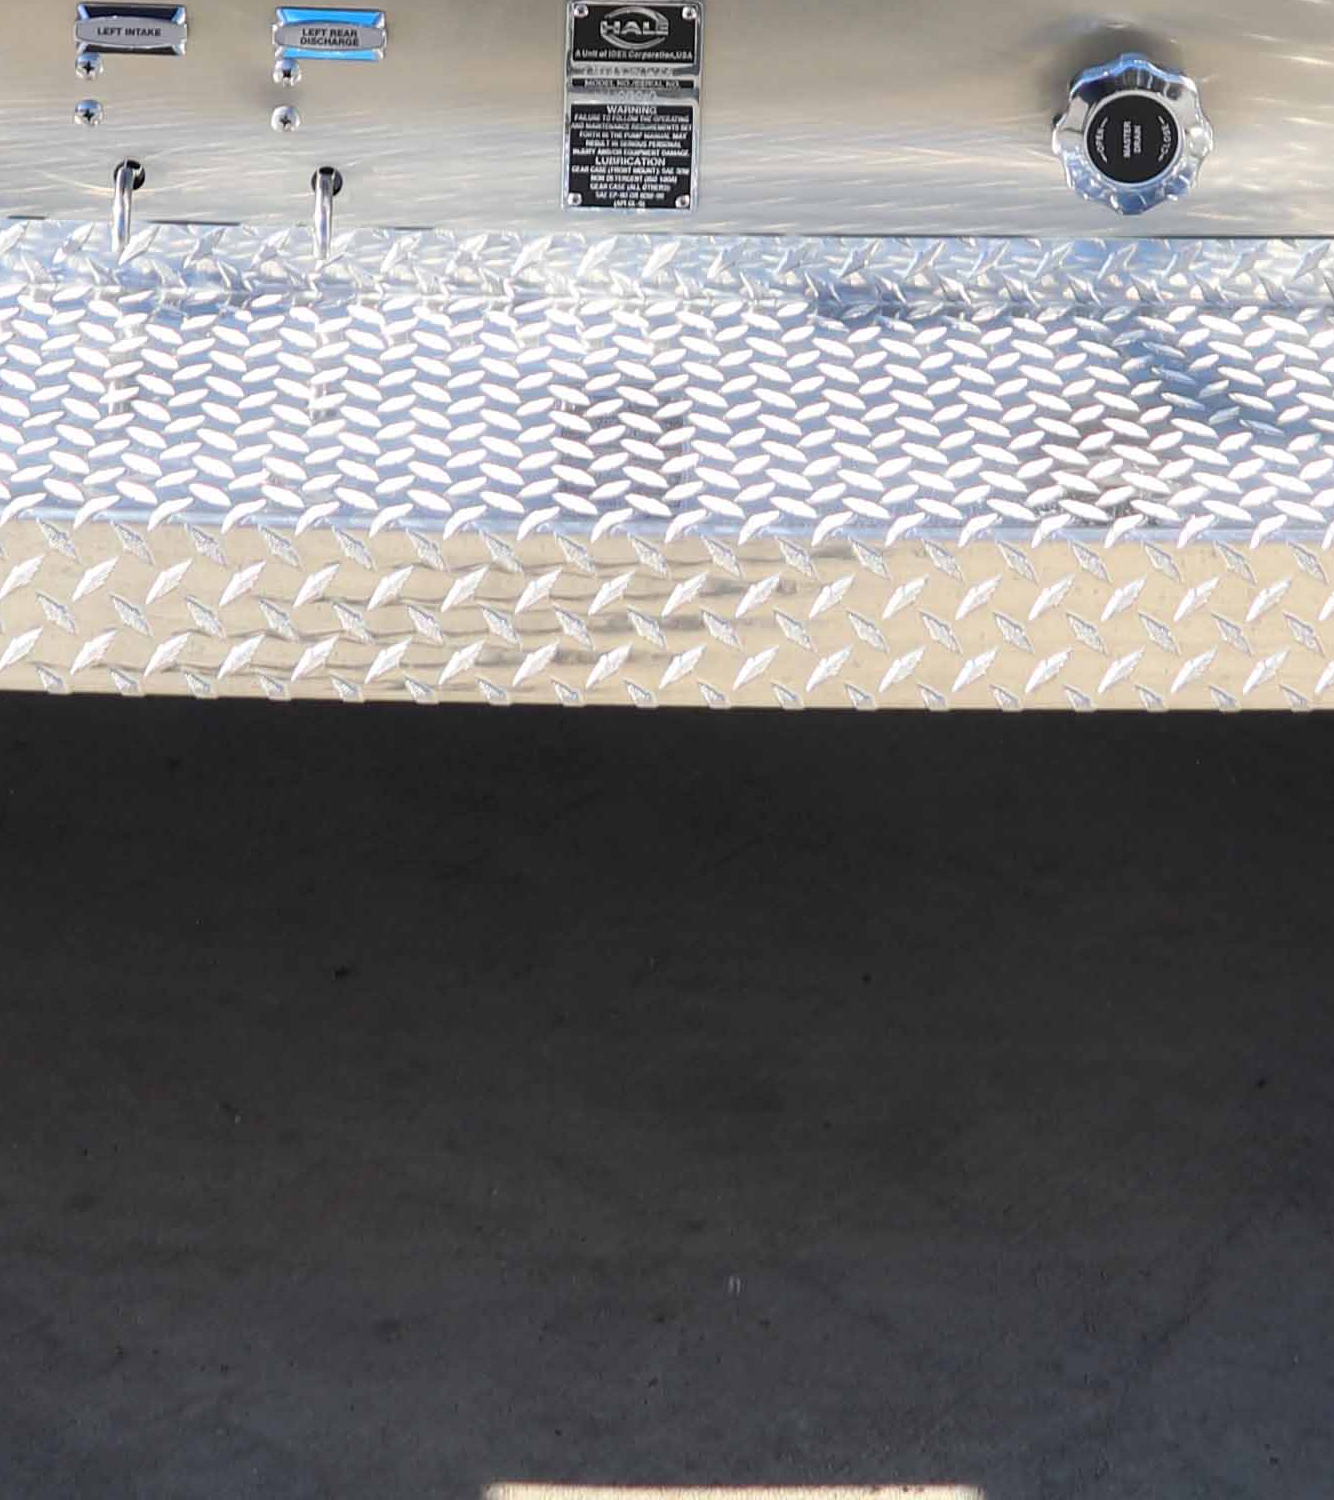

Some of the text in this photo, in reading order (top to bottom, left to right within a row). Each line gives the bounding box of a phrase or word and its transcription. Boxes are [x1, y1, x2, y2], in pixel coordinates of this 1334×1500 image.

[97, 27, 162, 38] LEFT INTAKE
[302, 28, 358, 39] LEFT REAR
[600, 20, 669, 36] HALE
[300, 37, 359, 48] DISCHARGE
